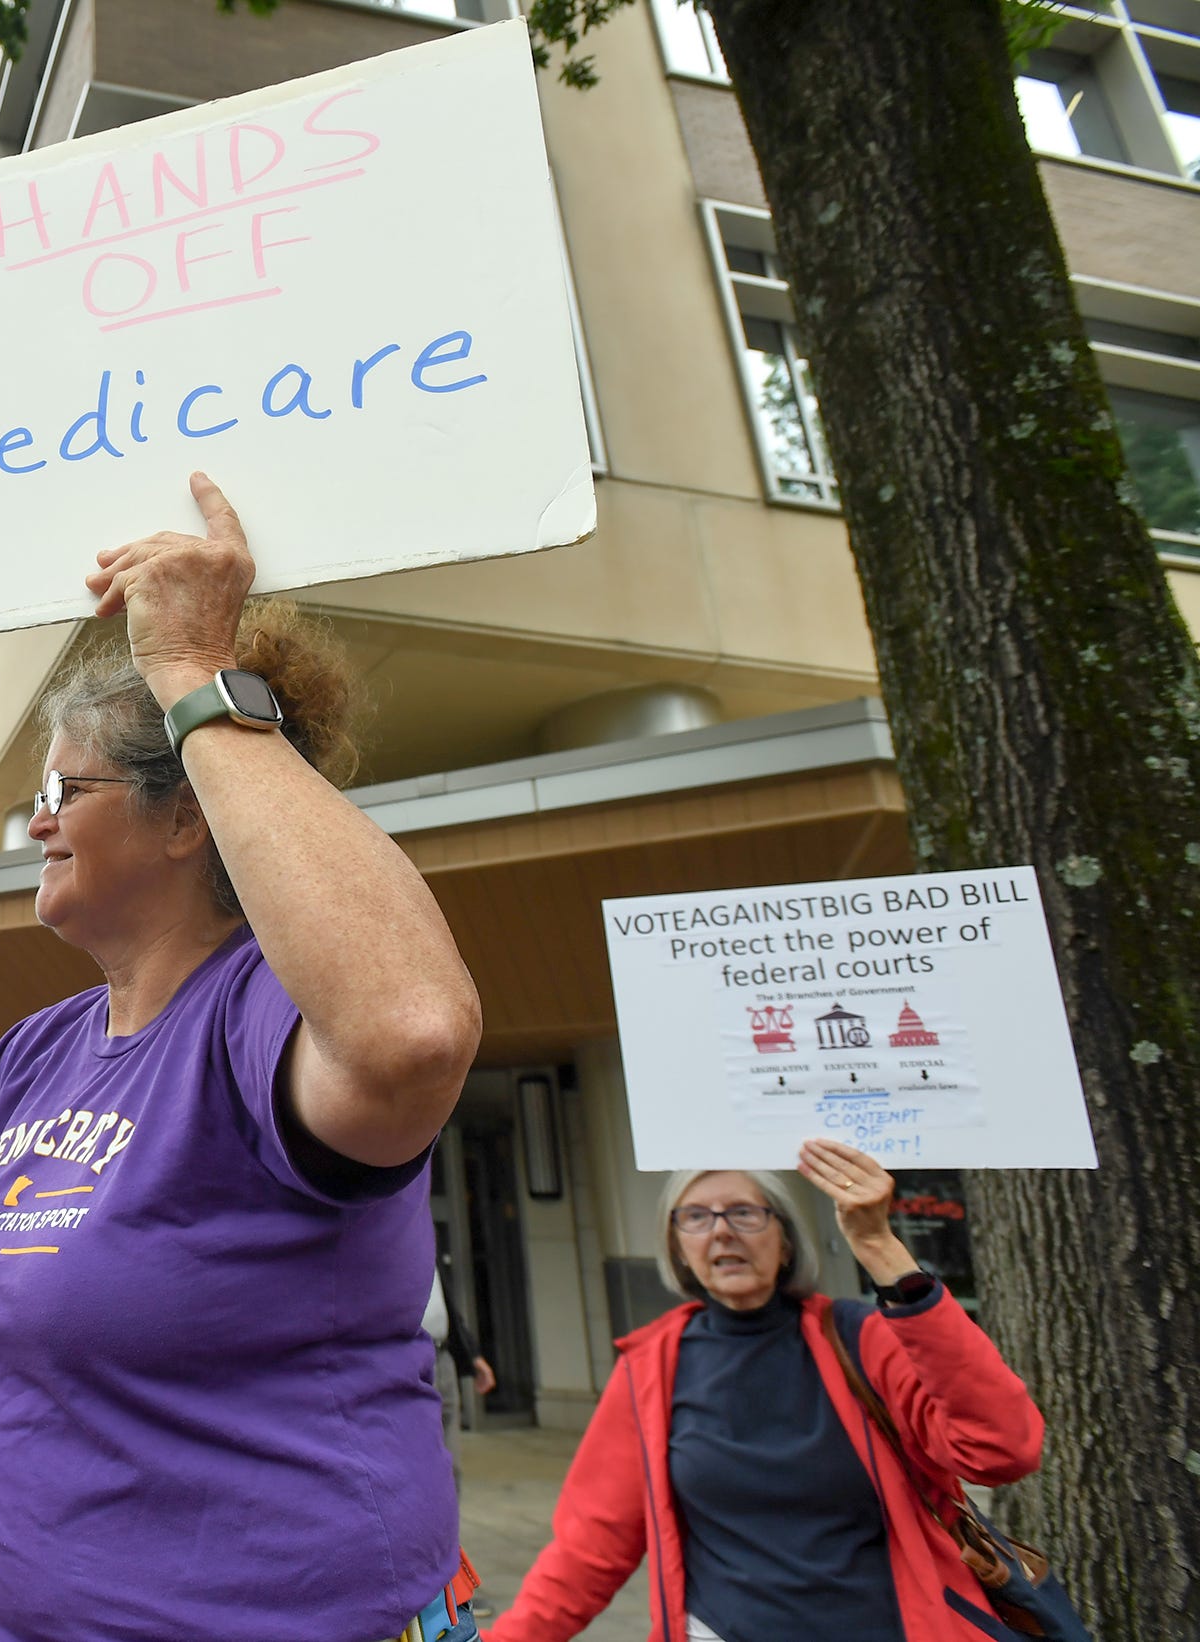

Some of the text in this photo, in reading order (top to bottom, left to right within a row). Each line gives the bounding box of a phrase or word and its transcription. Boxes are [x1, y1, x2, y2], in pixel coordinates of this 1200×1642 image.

[81, 206, 311, 318] OFF
[883, 886, 950, 913] BAD
[960, 880, 1029, 905] BILL
[670, 916, 991, 960] Protect the power of
[721, 953, 934, 988] federal courts
[756, 993, 776, 1002] The
[786, 989, 833, 1000] Branches
[835, 988, 847, 997] of
[849, 985, 916, 996] Government
[824, 1061, 879, 1072] EXECUTIVE
[815, 1101, 836, 1113] IF
[824, 1109, 924, 1128] CONTEMPT
[854, 1126, 883, 1140] OF
[843, 1135, 921, 1156] OURT!
[34, 1208, 90, 1229] SPORT
